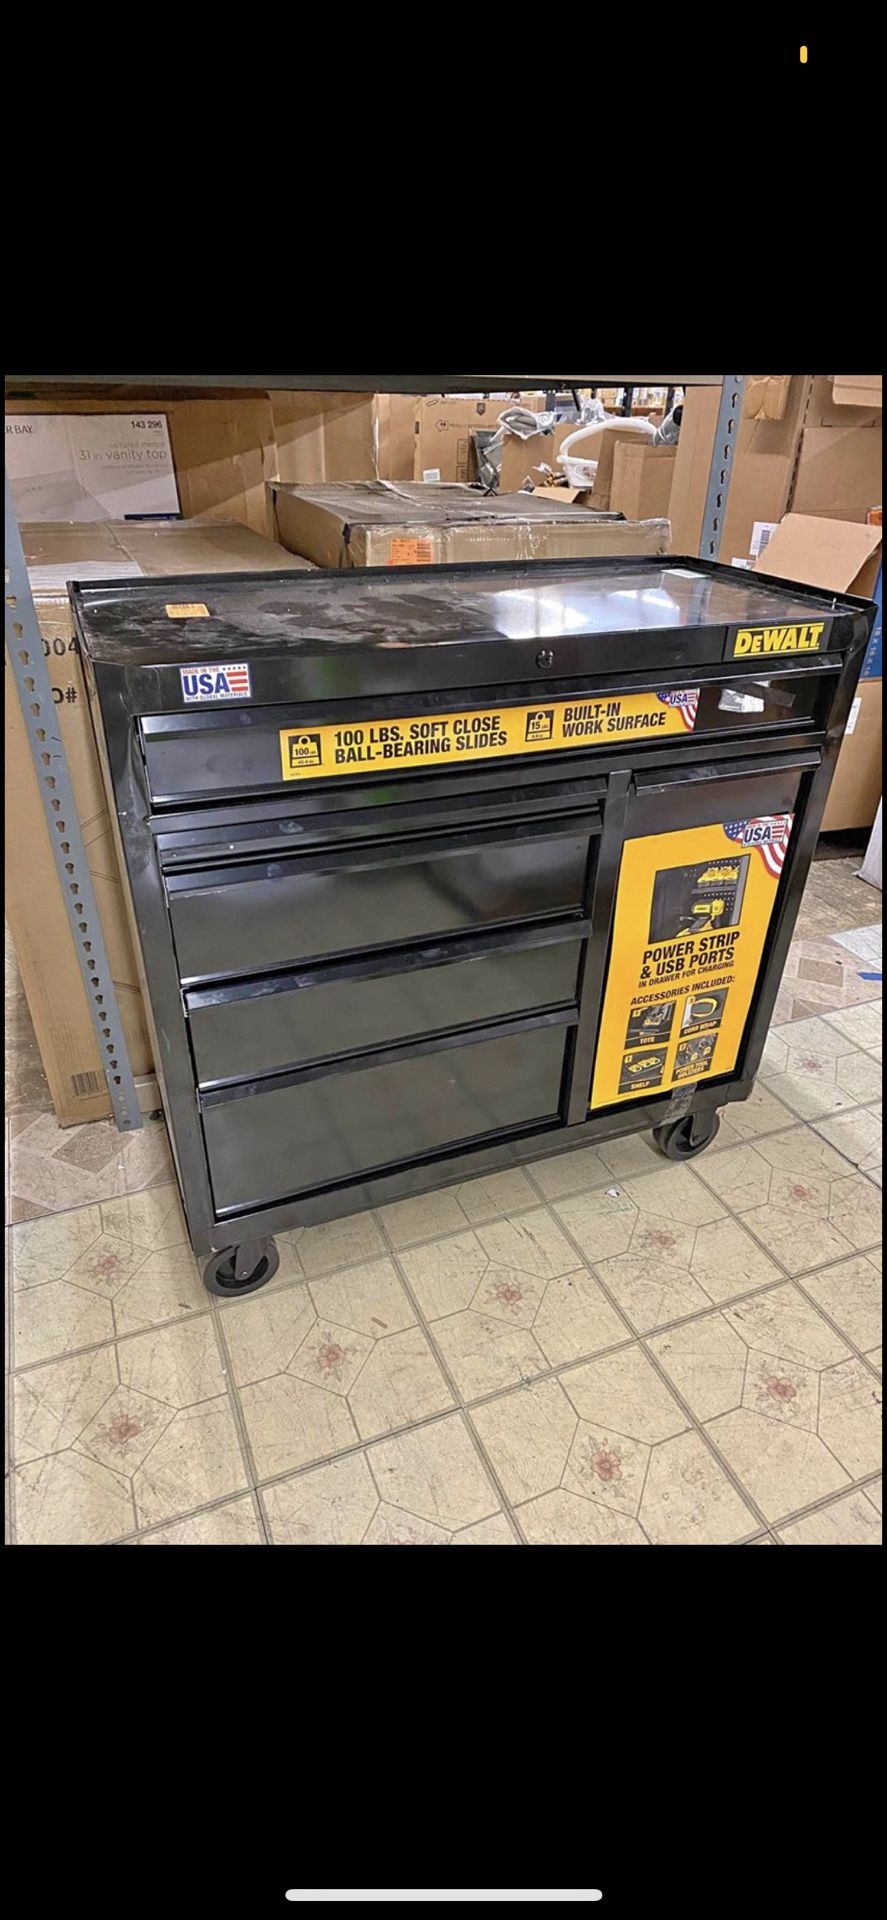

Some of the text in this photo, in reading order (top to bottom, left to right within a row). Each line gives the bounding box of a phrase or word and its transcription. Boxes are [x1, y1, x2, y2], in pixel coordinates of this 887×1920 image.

[14, 424, 33, 434] BAY
[131, 420, 163, 429] 143 296
[79, 449, 167, 462] 31 in vanity top
[183, 672, 230, 697] USA
[669, 692, 689, 705] USA
[563, 702, 621, 723] BUILT-IN
[334, 716, 501, 748] 100 LBS. SOFT CLOSE
[531, 720, 541, 730] 15
[562, 711, 667, 738] WORK SURFACE
[295, 747, 309, 756] 100
[335, 731, 508, 764] BALL-BEARING SLIDES
[744, 826, 771, 843] USA
[642, 931, 741, 965] POWER STRIP
[640, 946, 735, 980] & USB PORTS
[638, 960, 735, 989] IN DRAWER FOR CHARGING
[630, 975, 736, 1006] ACCESSORIES INCLUDED:
[640, 1036, 656, 1045] TOTE
[630, 1080, 651, 1091] SHELF
